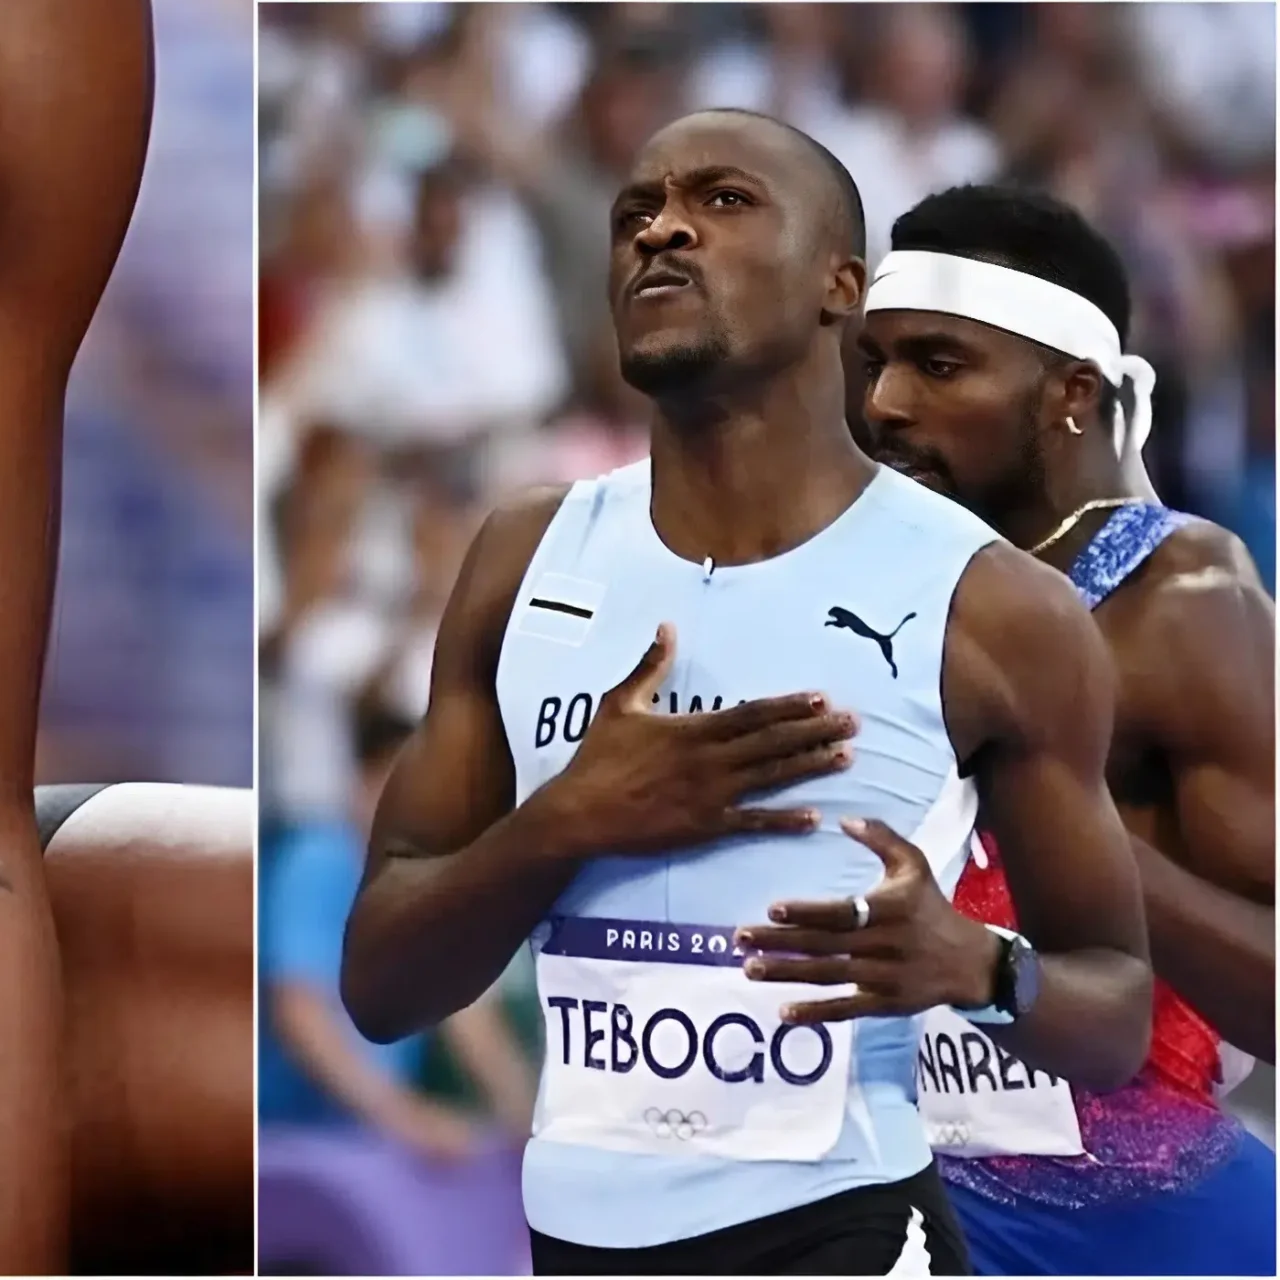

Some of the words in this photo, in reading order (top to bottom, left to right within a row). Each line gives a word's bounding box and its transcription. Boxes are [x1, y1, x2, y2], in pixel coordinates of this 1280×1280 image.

[606, 928, 680, 952] PARIS
[690, 933, 764, 957] 20
[547, 996, 834, 1087] TEBOGO
